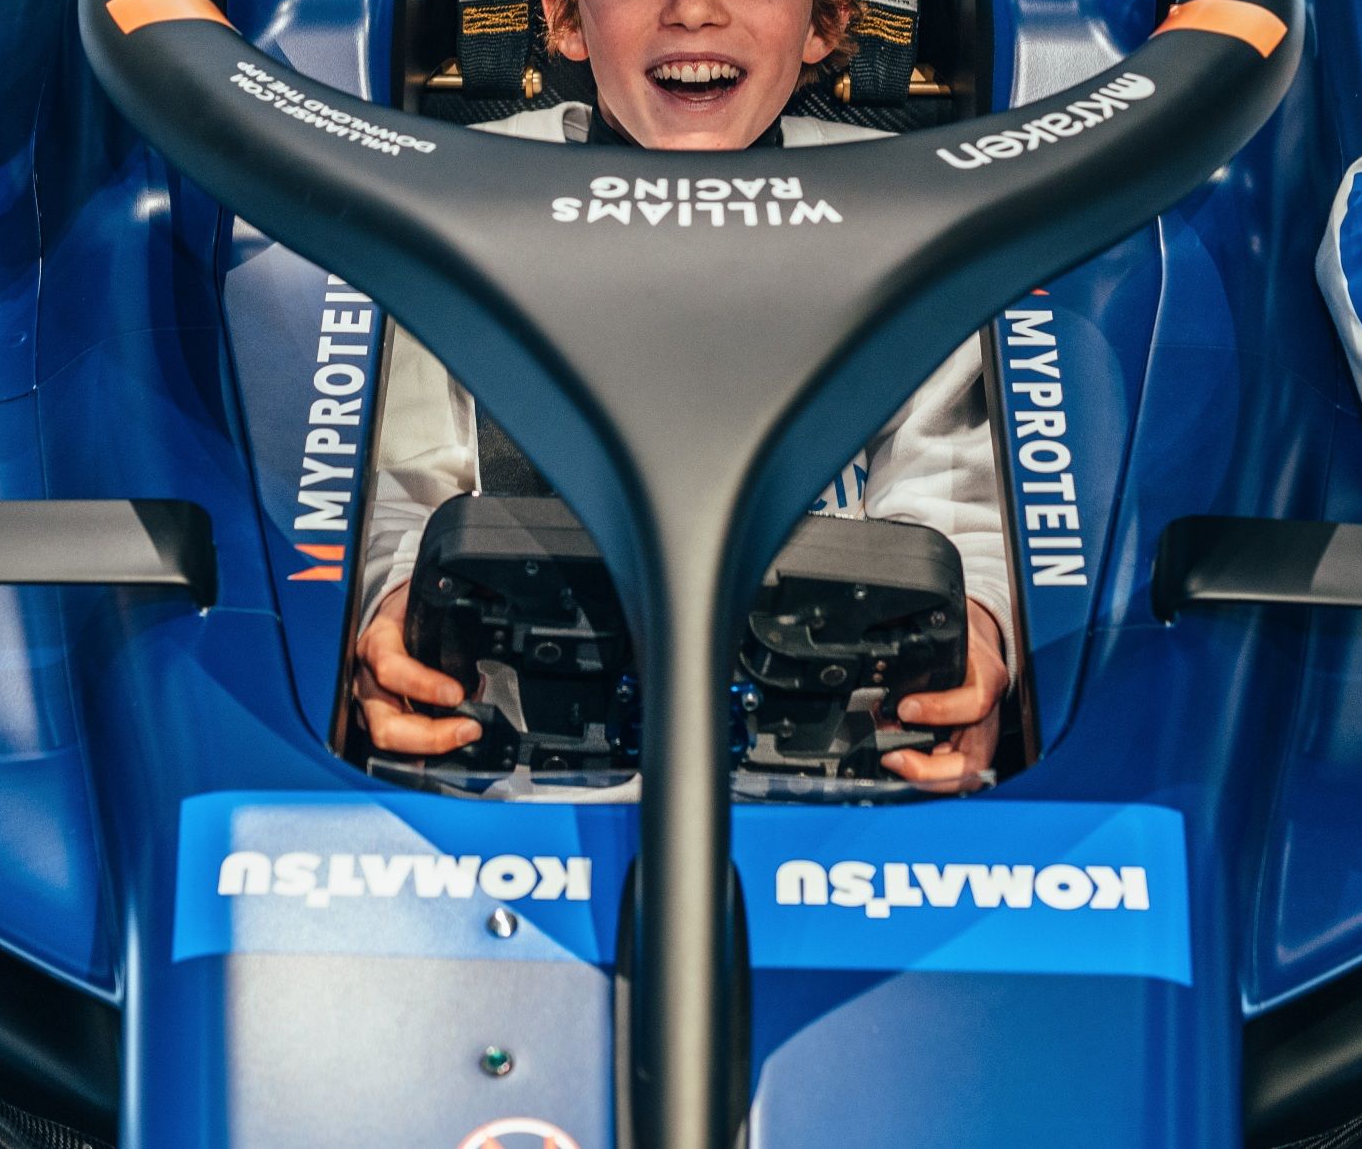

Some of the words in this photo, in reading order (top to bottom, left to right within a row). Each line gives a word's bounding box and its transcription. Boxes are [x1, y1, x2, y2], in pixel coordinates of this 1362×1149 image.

[237, 61, 274, 83] APP
[266, 83, 306, 104] THE
[229, 73, 401, 156] WILLIAMSF1.COM
[303, 99, 437, 154] DOWNLOAD
[936, 91, 1129, 170] kraken
[551, 197, 844, 227] WILLIAMS
[589, 176, 803, 200] RACING
[293, 274, 375, 531] MYPROTEI
[1004, 310, 1087, 587] MYPROTEIN
[217, 851, 592, 907] KOMATSU
[775, 859, 1150, 918] KOMATSU
